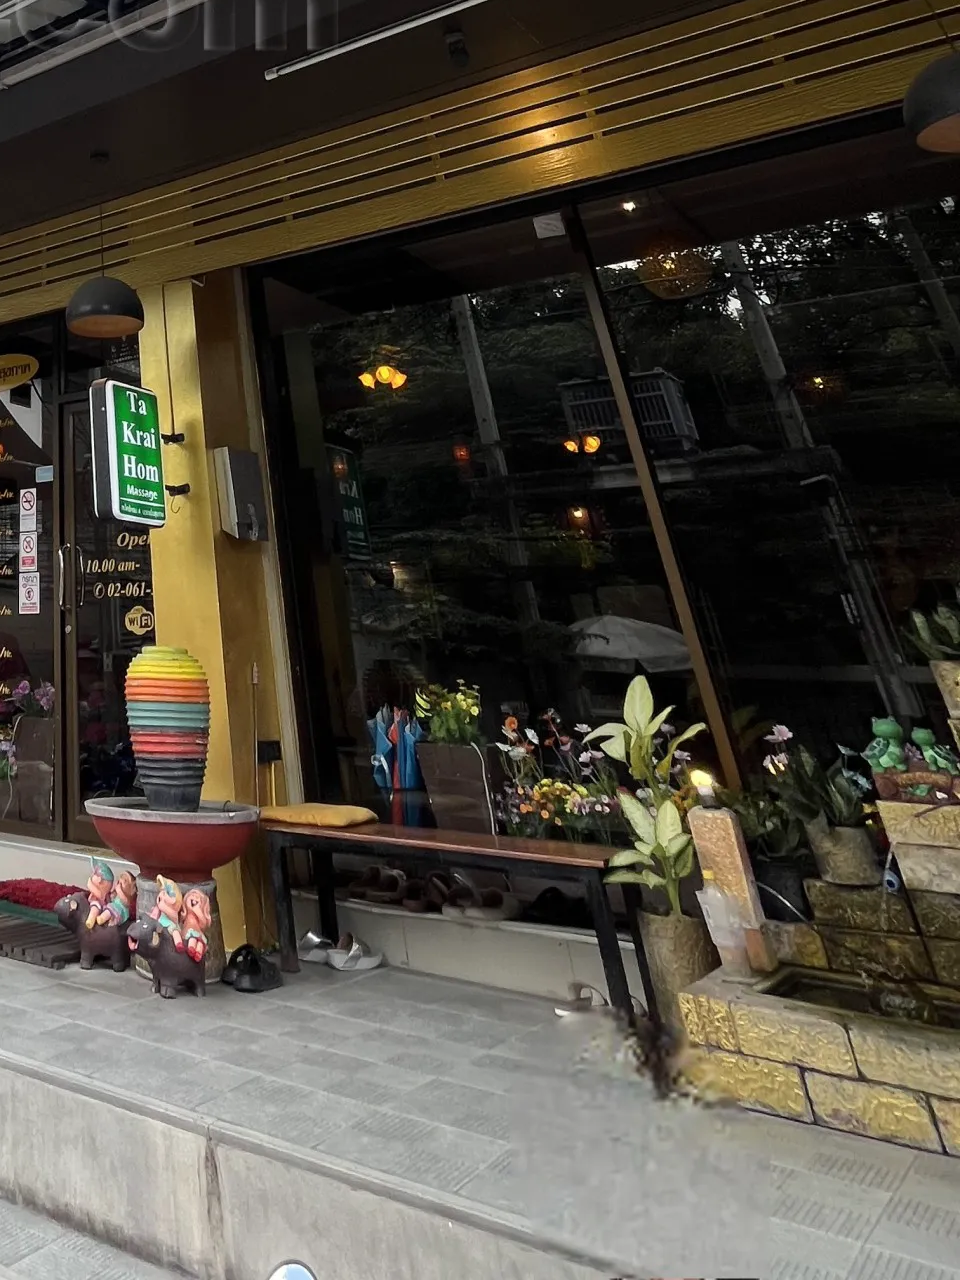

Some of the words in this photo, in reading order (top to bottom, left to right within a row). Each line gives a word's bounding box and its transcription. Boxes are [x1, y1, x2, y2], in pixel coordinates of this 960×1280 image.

[126, 391, 147, 415] Ta
[122, 421, 156, 449] Krai
[123, 454, 159, 482] Hom
[127, 484, 158, 501] Massage
[117, 532, 151, 549] Ope
[86, 559, 115, 573] 10.00
[107, 581, 153, 597] 02-061-
